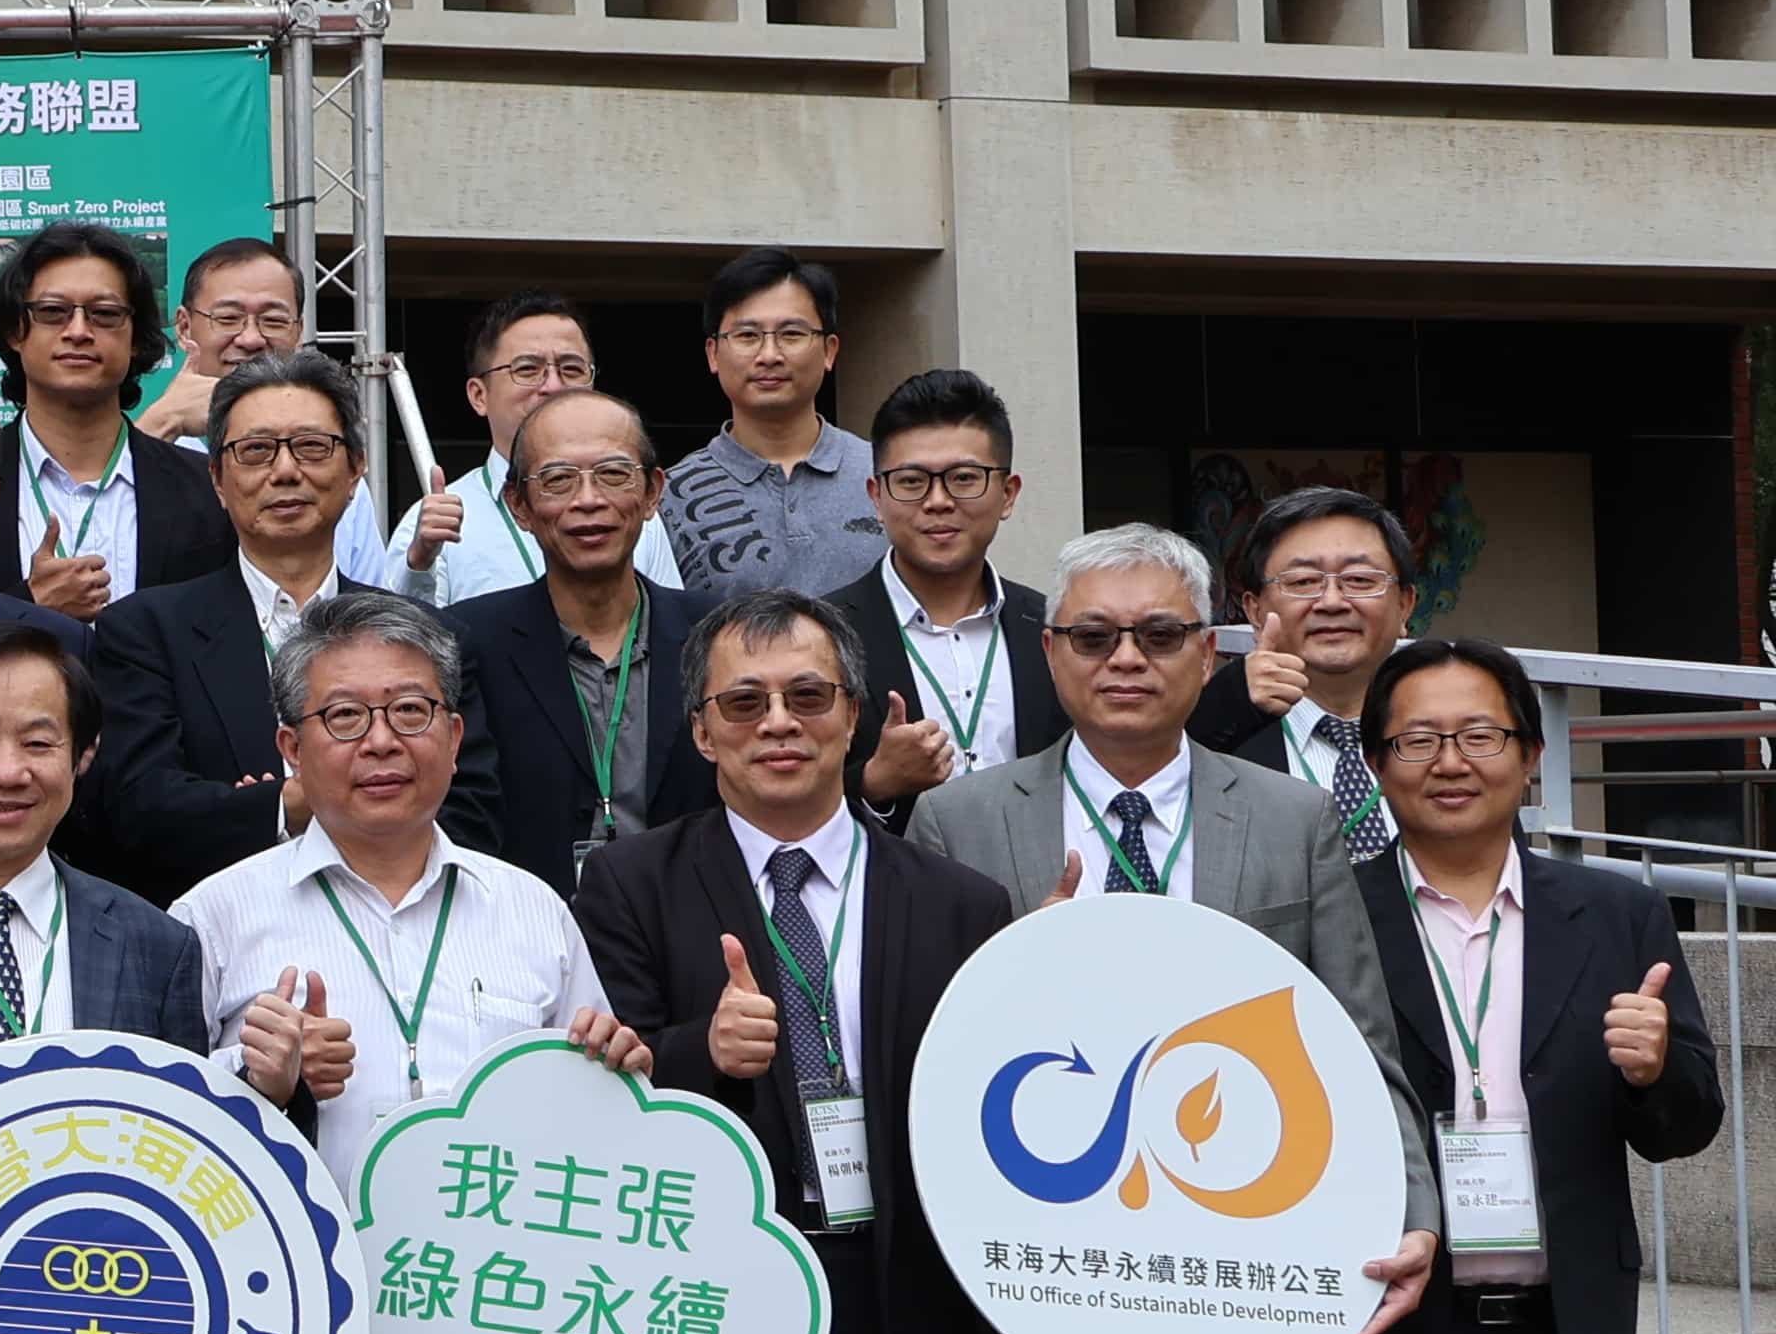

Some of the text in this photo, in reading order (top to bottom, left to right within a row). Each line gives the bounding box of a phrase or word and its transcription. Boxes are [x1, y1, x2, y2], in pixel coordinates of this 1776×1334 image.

[27, 201, 70, 216] Smart
[74, 200, 109, 214] Zero
[112, 198, 167, 214] Project
[437, 1142, 697, 1254] 我主張
[982, 1240, 1346, 1297] 東海大學永續發展辦公室
[986, 1281, 1347, 1328] THU Office of Sustainable Development
